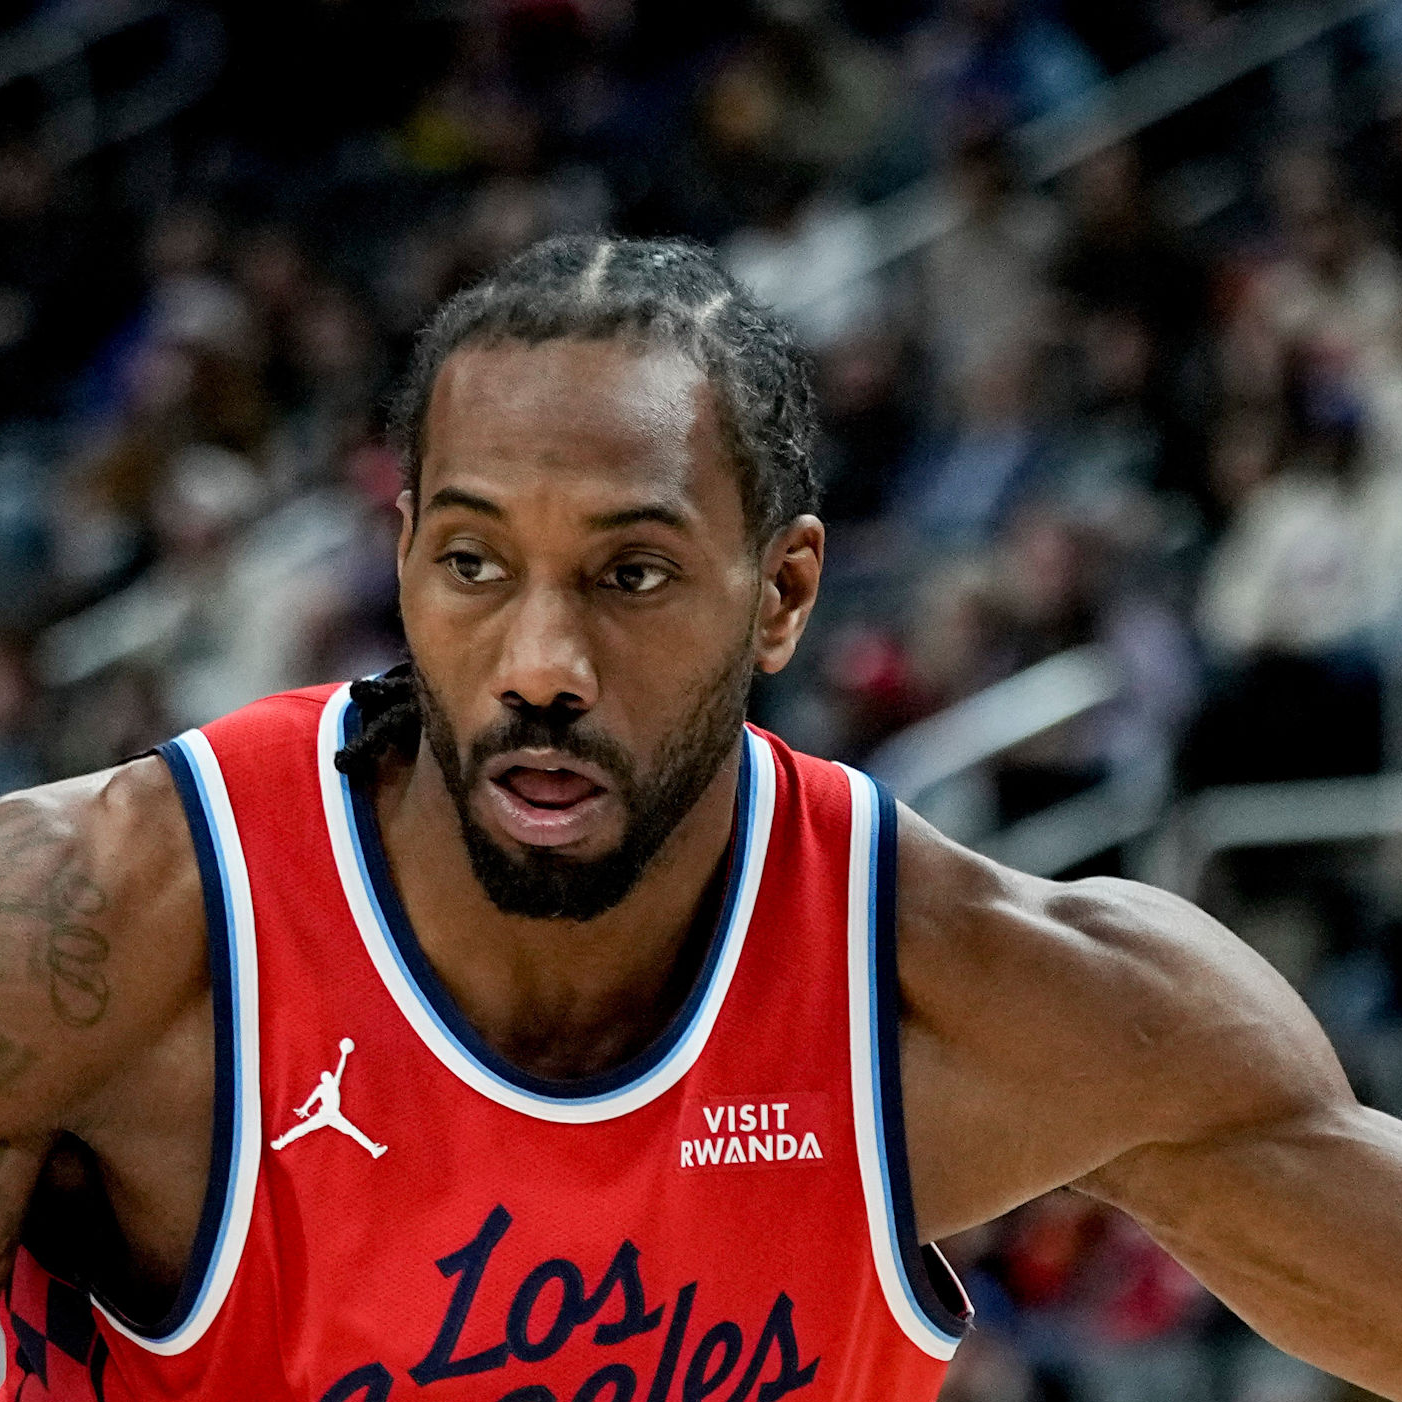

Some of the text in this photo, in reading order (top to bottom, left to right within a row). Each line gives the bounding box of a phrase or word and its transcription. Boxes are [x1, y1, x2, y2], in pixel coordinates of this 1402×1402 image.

[702, 1103, 790, 1134] VISIT
[680, 1132, 824, 1168] RWANDA
[409, 1204, 666, 1388] Los
